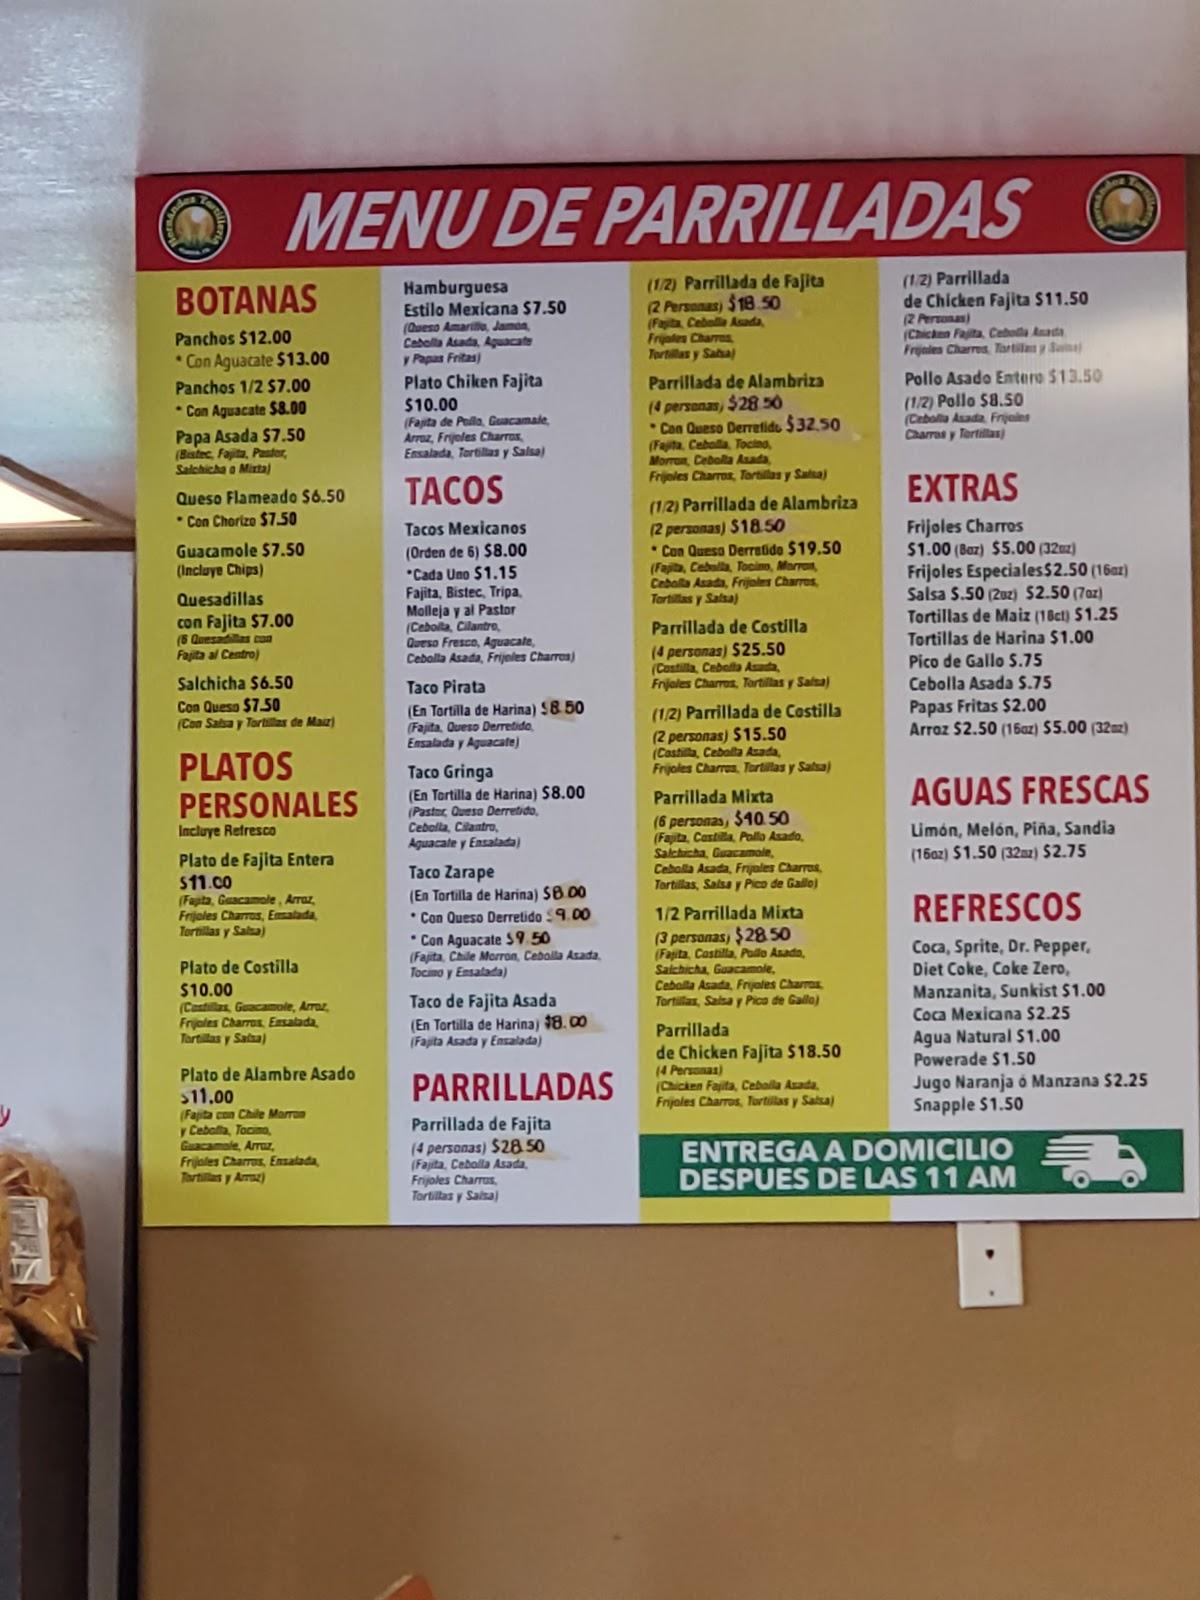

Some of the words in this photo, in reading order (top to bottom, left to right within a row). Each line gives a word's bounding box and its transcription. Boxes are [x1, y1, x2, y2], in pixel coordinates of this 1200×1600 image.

[286, 189, 489, 251] MENU
[492, 187, 592, 247] DE
[594, 178, 1032, 245] PARRILLADAS
[404, 280, 508, 298] Hamburguesa
[685, 275, 757, 289] Parrillada
[762, 274, 780, 289] de
[784, 274, 825, 292] Fajita
[177, 284, 316, 316] BOTANAS
[404, 302, 444, 317] Estilo
[449, 301, 518, 316] Mexicana
[524, 300, 566, 315] $7.50
[904, 294, 922, 308] de
[926, 293, 985, 308] Chicken
[990, 292, 1030, 311] Fajita
[1036, 292, 1088, 306] $11.50
[176, 332, 235, 346] Panchos
[240, 330, 291, 345] $12.00
[187, 354, 210, 368] Con
[215, 354, 273, 372] Aguacate
[277, 351, 329, 367] $13.00
[176, 380, 235, 395] Panchos
[240, 380, 263, 394] 1/2
[268, 378, 310, 394] $7.00
[405, 375, 442, 390] Plato
[446, 374, 498, 389] Chiken
[503, 373, 542, 392] Fajita
[649, 375, 721, 390] Parrillada
[726, 374, 744, 389] de
[748, 374, 824, 389] Alambriza
[406, 398, 458, 412] $10.00
[176, 430, 210, 447] Papa
[215, 428, 258, 443] Asada
[264, 428, 305, 443] $7.50
[405, 475, 503, 505] TACOS
[909, 472, 1018, 503] EXTRAS
[176, 492, 222, 506] Queso
[227, 489, 297, 505] Flameado
[302, 489, 345, 504] $6.50
[405, 522, 444, 536] Tacos
[449, 520, 526, 535] Mexicanos
[908, 519, 962, 538] Frijoles
[966, 518, 1023, 533] Charros
[176, 542, 257, 558] Guacamole
[262, 542, 304, 557] $7.50
[406, 546, 445, 561] (Orden
[450, 547, 463, 558] de
[484, 543, 527, 558] $8.00
[788, 541, 841, 556] $19.50
[908, 542, 951, 557] $1.00
[992, 540, 1035, 555] $5.00
[177, 564, 223, 578] (Incluye
[227, 563, 263, 578] Chips)
[177, 592, 263, 607] Quesadillas
[178, 618, 202, 629] con
[207, 614, 246, 632] Fajita
[252, 614, 294, 629] $7.00
[652, 620, 724, 635] Parrillada
[730, 619, 747, 634] de
[752, 618, 807, 633] Costilla
[908, 631, 968, 646] Tortillas
[973, 631, 991, 645] de
[996, 630, 1045, 645] Harina
[1050, 630, 1094, 645] $1.00
[910, 654, 939, 669] Pico
[944, 654, 961, 668] de
[966, 653, 1004, 668] Gallo
[1010, 653, 1042, 667] $.75
[178, 676, 245, 691] Salchicha
[251, 676, 293, 690] $6.50
[910, 700, 953, 718] Papas
[958, 698, 998, 713] Fritas
[1003, 698, 1046, 713] $2.00
[667, 730, 728, 745] personas)
[734, 727, 786, 741] $15.50
[180, 751, 292, 781] PLATOS
[408, 765, 439, 779] Taco
[444, 764, 493, 782] Gringa
[409, 789, 428, 803] (En
[432, 789, 471, 801] Tortilla
[476, 788, 489, 800] de
[494, 789, 537, 801] Harina)
[542, 786, 585, 800] $8.00
[654, 789, 727, 805] Parrillada
[732, 789, 773, 803] Mixta
[912, 776, 1011, 806] AGUAS
[1023, 774, 1149, 804] FRESCAS
[181, 791, 358, 819] PERSONALES
[912, 822, 962, 838] Limón,
[967, 822, 1018, 838] Melón,
[1024, 822, 1060, 837] Piña,
[409, 866, 440, 879] Taco
[445, 865, 494, 883] Zarape
[656, 907, 680, 921] 1/2
[684, 905, 756, 920] Parrillada
[762, 905, 803, 919] Mixta
[914, 892, 1081, 922] REFRESCOS
[912, 940, 950, 955] Coca,
[955, 939, 1003, 958] Sprite,
[1009, 939, 1029, 952] Dr.
[1034, 939, 1090, 956] Pepper,
[181, 960, 217, 975] Plato
[222, 960, 239, 974] de
[244, 959, 298, 974] Costilla
[181, 983, 232, 997] $10.00
[410, 995, 441, 1008] Taco
[446, 994, 464, 1008] de
[469, 994, 508, 1012] Fajita
[513, 993, 556, 1007] Asada
[657, 1022, 729, 1037] Parrillada
[914, 1030, 951, 1048] Agua
[957, 1029, 1011, 1043] Natural
[1017, 1029, 1060, 1043] $1.00
[656, 1045, 674, 1060] de
[679, 1045, 737, 1060] Chicken
[743, 1044, 782, 1063] Fajita
[788, 1044, 841, 1059] $18.50
[914, 1052, 987, 1066] Powerade
[992, 1052, 1035, 1066] $1.50
[181, 1067, 218, 1082] Plato
[223, 1067, 240, 1081] de
[244, 1066, 307, 1081] Alambre
[310, 1066, 355, 1081] Asado
[914, 1076, 951, 1093] Jugo
[956, 1074, 1013, 1092] Naranja
[1032, 1074, 1099, 1088] Manzana
[1104, 1073, 1148, 1087] $2.25
[414, 1072, 613, 1102] PARRILLADAS
[914, 1097, 975, 1116] Snapple
[980, 1097, 1023, 1111] $1.50
[412, 1116, 484, 1131] Parrillada
[489, 1116, 507, 1131] de
[512, 1116, 551, 1135] Fajita
[427, 1143, 486, 1156] personas)
[683, 1140, 819, 1163] ENTREGA
[823, 1140, 847, 1161] A
[852, 1137, 1013, 1161] DOMICILIO
[680, 1167, 809, 1191] DESPUES
[817, 1167, 856, 1189] DE
[863, 1166, 917, 1189] LAS
[925, 1166, 957, 1188] 11
[967, 1165, 1016, 1188] AM
